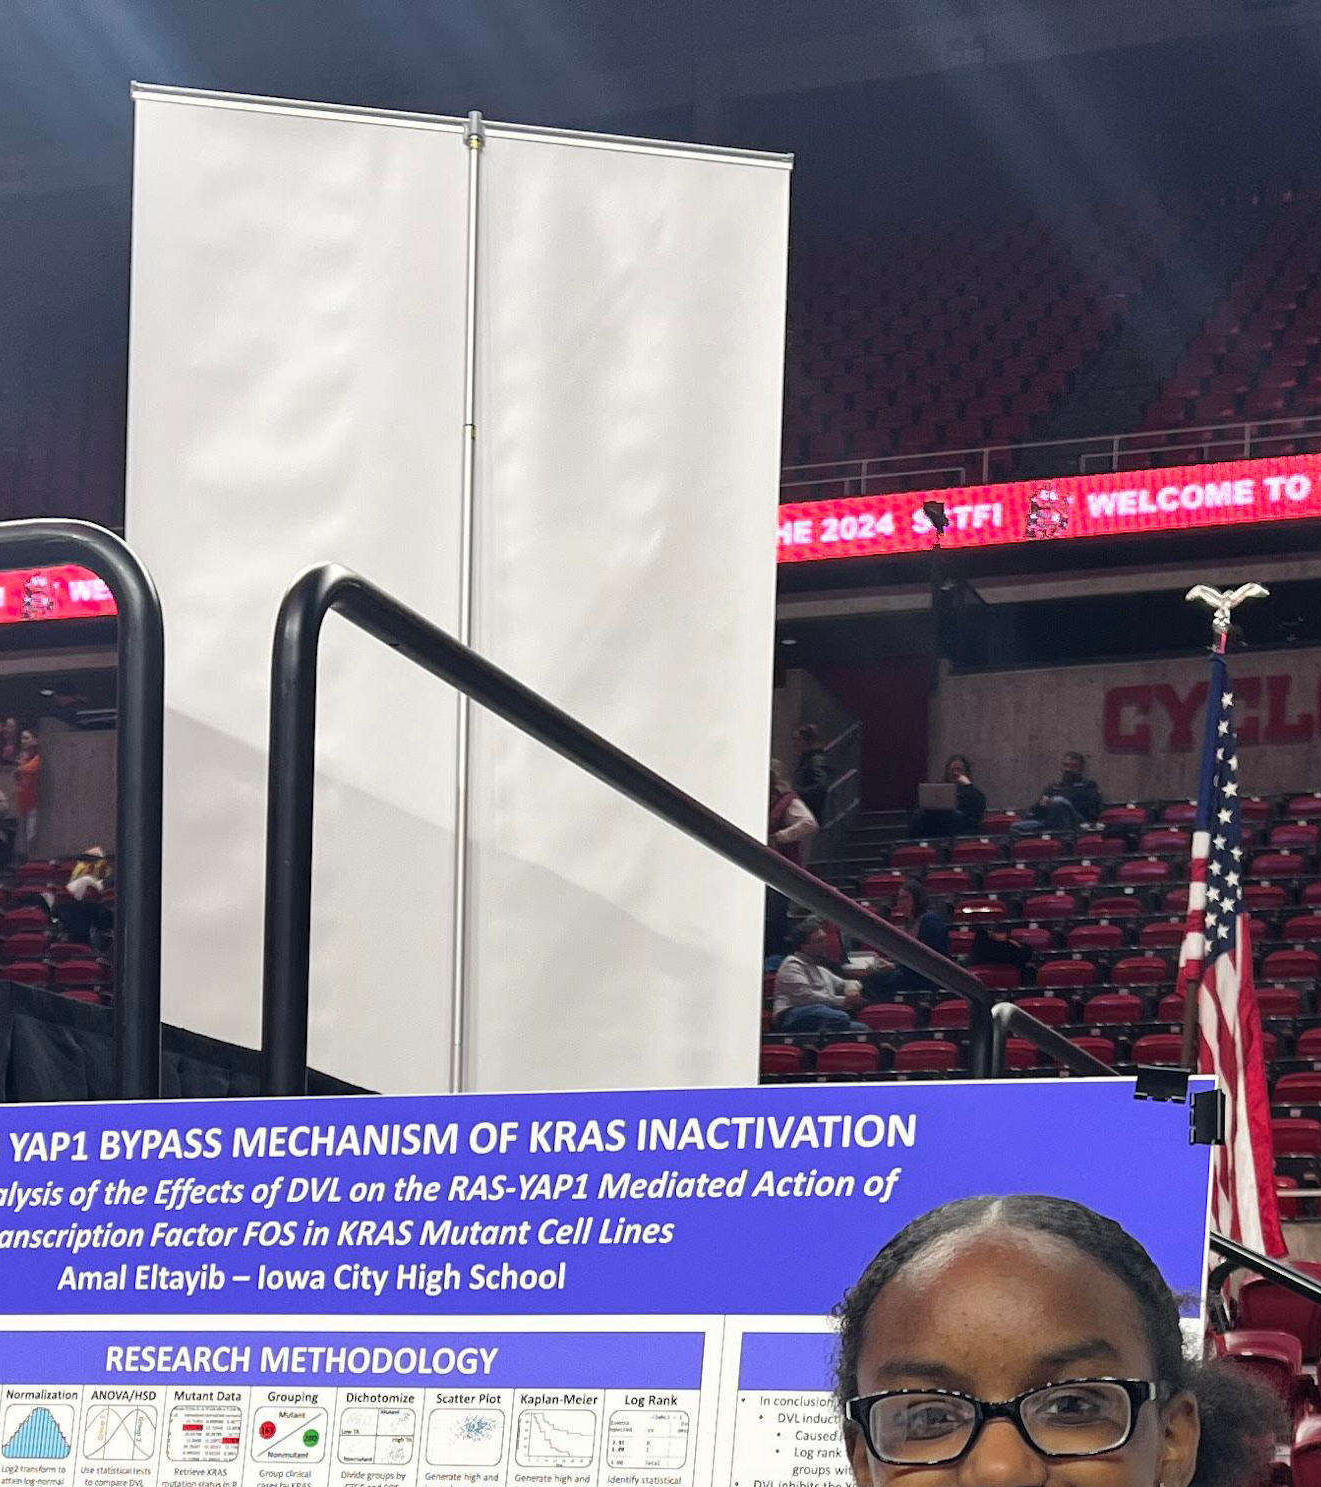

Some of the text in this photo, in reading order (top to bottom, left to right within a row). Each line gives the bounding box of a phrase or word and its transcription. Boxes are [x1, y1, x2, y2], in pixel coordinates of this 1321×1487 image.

[1088, 477, 1254, 518] WELCOME
[1264, 473, 1312, 503] TO
[819, 512, 895, 544] 2024
[913, 503, 1001, 536] STFI
[10, 1131, 88, 1162] YAP1
[100, 1128, 222, 1160] BYPASS
[232, 1123, 459, 1158] MECHANISM
[470, 1122, 518, 1154] OF
[530, 1119, 625, 1153] KRAS
[638, 1114, 916, 1151] INACTIVATION
[69, 1179, 100, 1211] of
[104, 1179, 148, 1205] the
[154, 1178, 245, 1210] Effects
[251, 1176, 284, 1209] of
[287, 1177, 341, 1202] DVL
[349, 1182, 385, 1202] on
[394, 1174, 441, 1202] the
[448, 1173, 588, 1201] RAS-YAP1
[598, 1170, 745, 1199] Mediated
[751, 1169, 855, 1197] Action
[864, 1168, 902, 1203] of
[150, 1222, 238, 1247] Factor
[243, 1221, 297, 1246] FOS
[303, 1220, 329, 1246] in
[337, 1220, 414, 1245] KRAS
[419, 1220, 531, 1245] Mutant
[538, 1217, 593, 1244] Cell
[599, 1217, 675, 1244] Lines
[57, 1262, 566, 1296] Amal Eltayib Iowa City High School
[106, 1346, 499, 1374] RESEARCH METHODOLOGY
